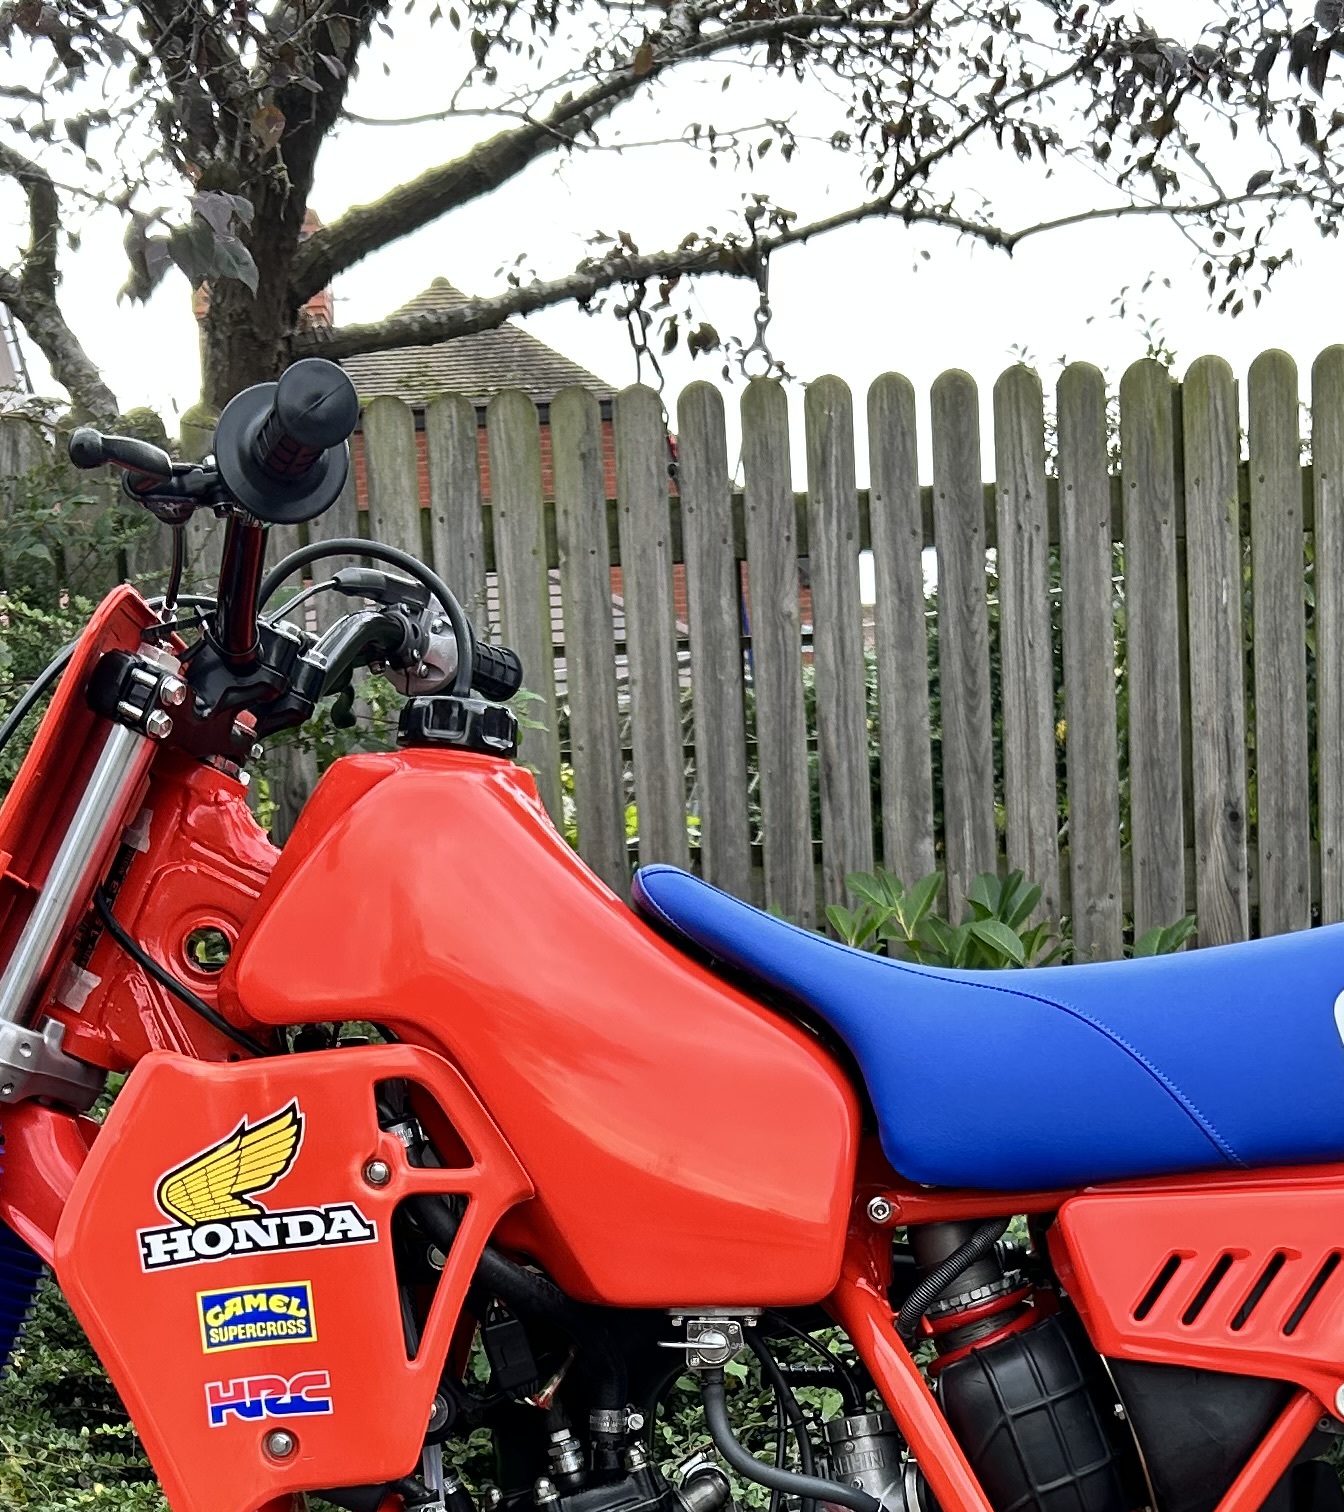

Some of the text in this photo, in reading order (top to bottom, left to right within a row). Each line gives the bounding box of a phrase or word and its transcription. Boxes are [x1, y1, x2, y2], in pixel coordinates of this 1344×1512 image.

[143, 1209, 370, 1265] HONDA
[206, 1293, 307, 1327] CAMEL
[209, 1319, 307, 1343] SUPERCROSS
[204, 1370, 333, 1428] HRC
